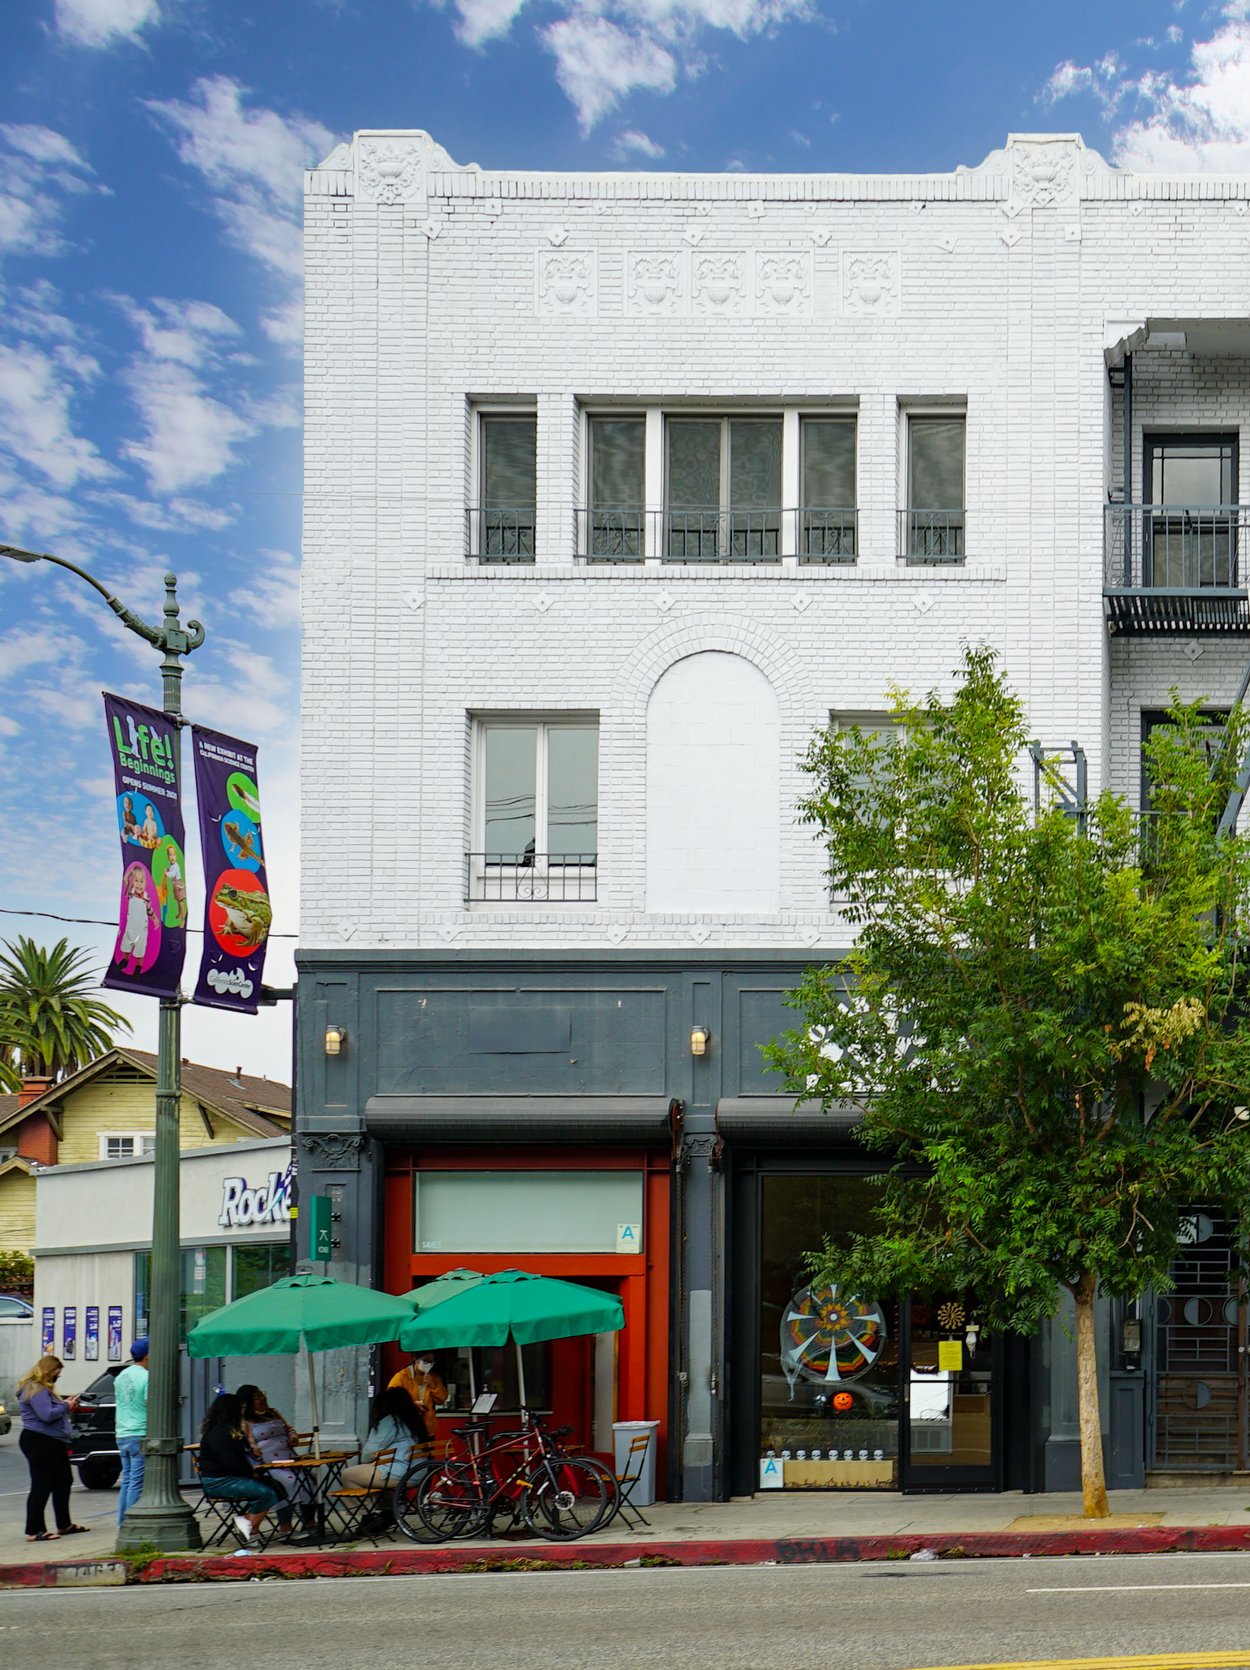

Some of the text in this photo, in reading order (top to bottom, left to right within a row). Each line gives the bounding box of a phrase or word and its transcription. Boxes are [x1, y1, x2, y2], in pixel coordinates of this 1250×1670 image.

[112, 715, 174, 770] Life!
[119, 752, 176, 785] Beginnings
[621, 1225, 635, 1240] A
[764, 1458, 778, 1474] A
